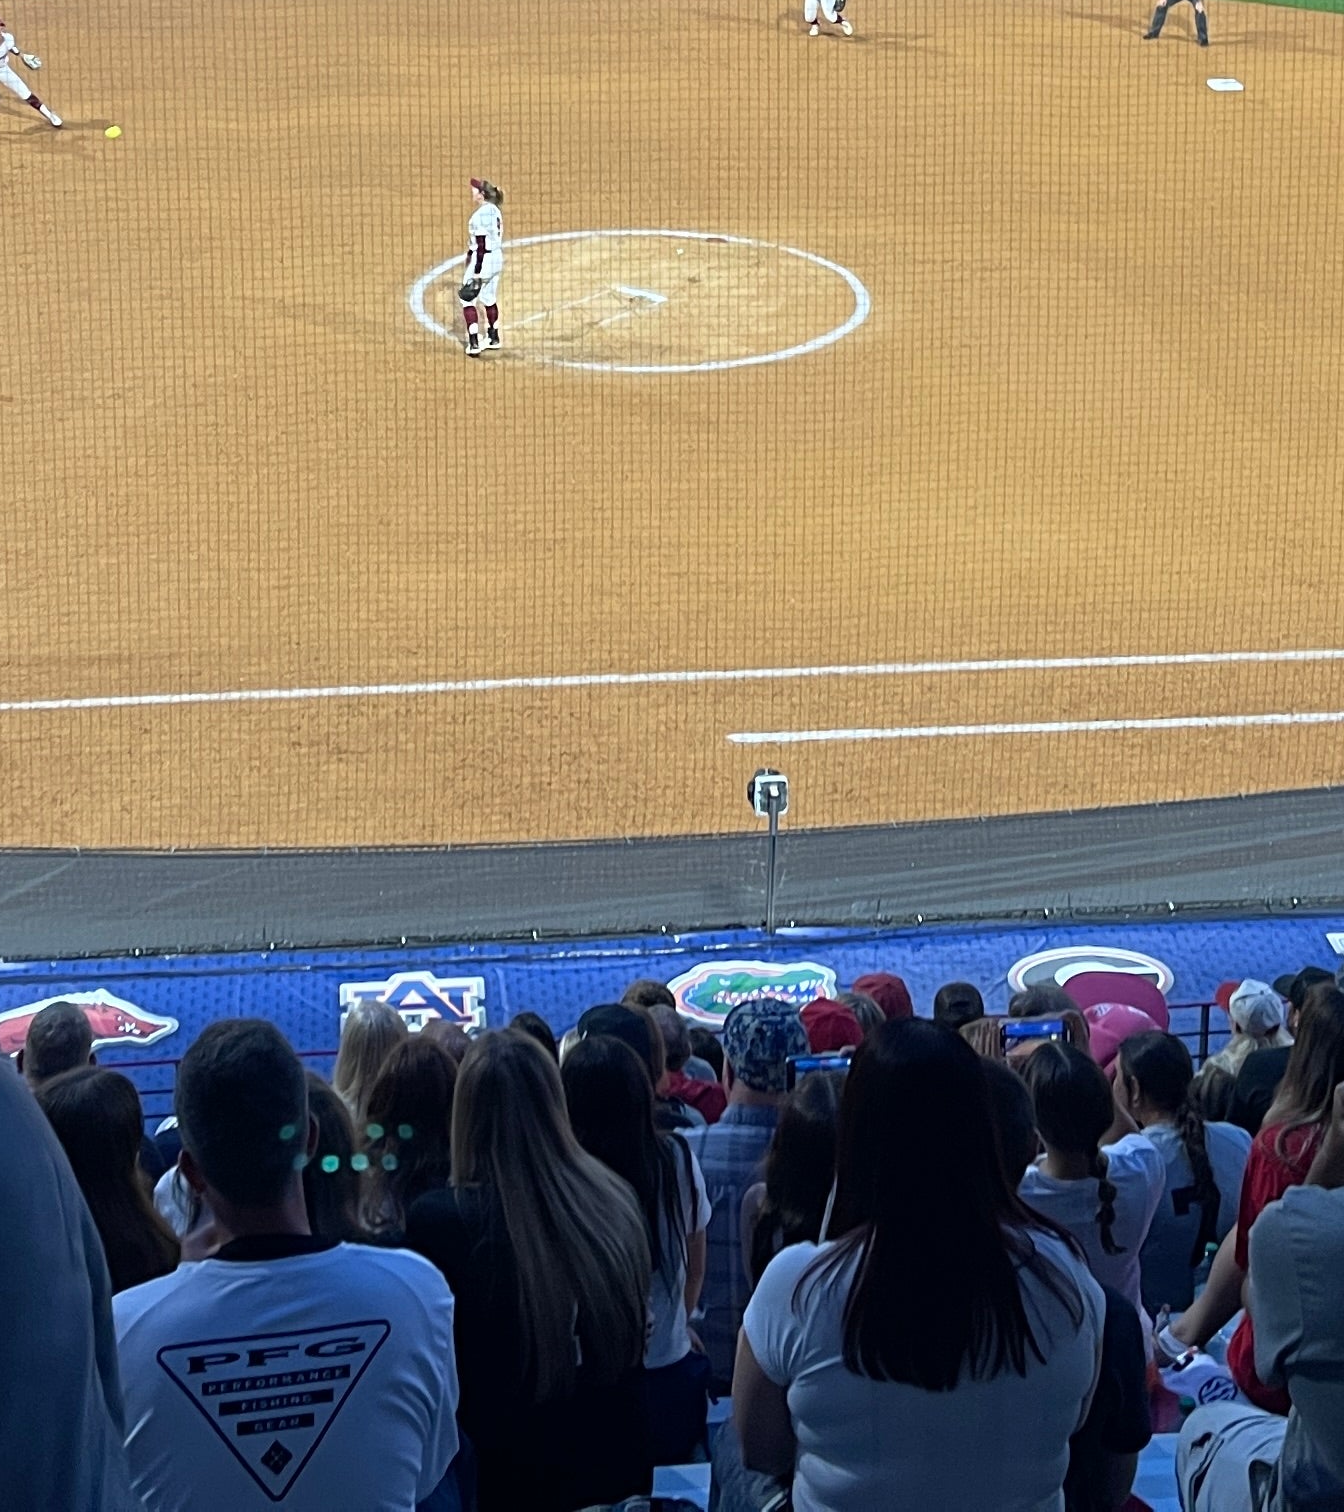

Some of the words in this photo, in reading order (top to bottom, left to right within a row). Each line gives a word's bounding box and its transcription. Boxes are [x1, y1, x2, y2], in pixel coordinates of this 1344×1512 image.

[186, 1336, 366, 1375] PFG
[207, 1367, 344, 1394] PERFORMANCE
[240, 1394, 313, 1412] FISHING
